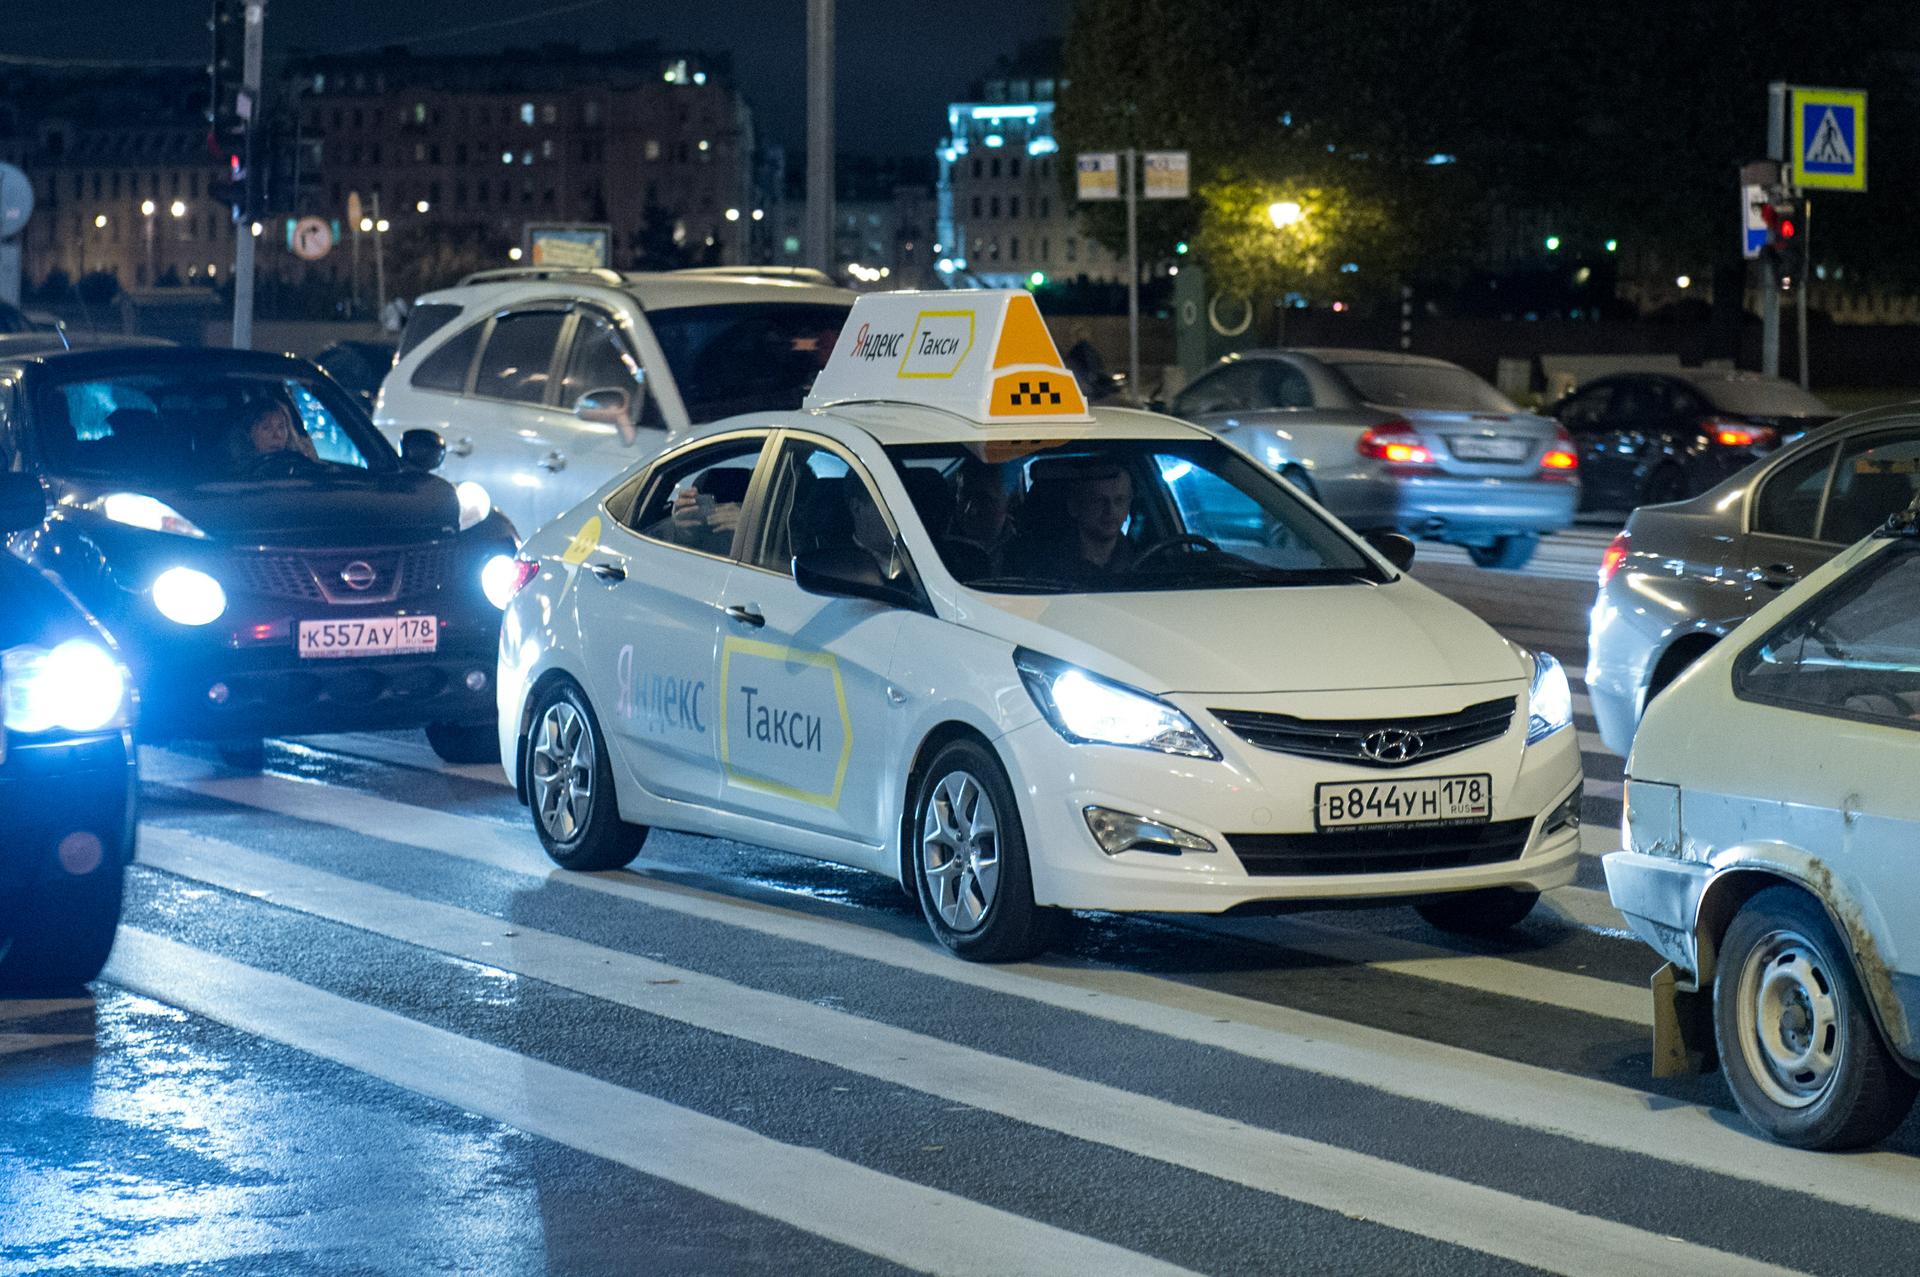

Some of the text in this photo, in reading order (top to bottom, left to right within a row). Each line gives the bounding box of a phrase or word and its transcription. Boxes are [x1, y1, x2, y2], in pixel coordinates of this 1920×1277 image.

[850, 323, 960, 361] Яндекс Такси
[308, 620, 431, 648] К557АУ 178
[617, 644, 821, 752] Яндекс Такси
[1329, 779, 1481, 820] В844УН 178
[1450, 803, 1471, 814] RUS
